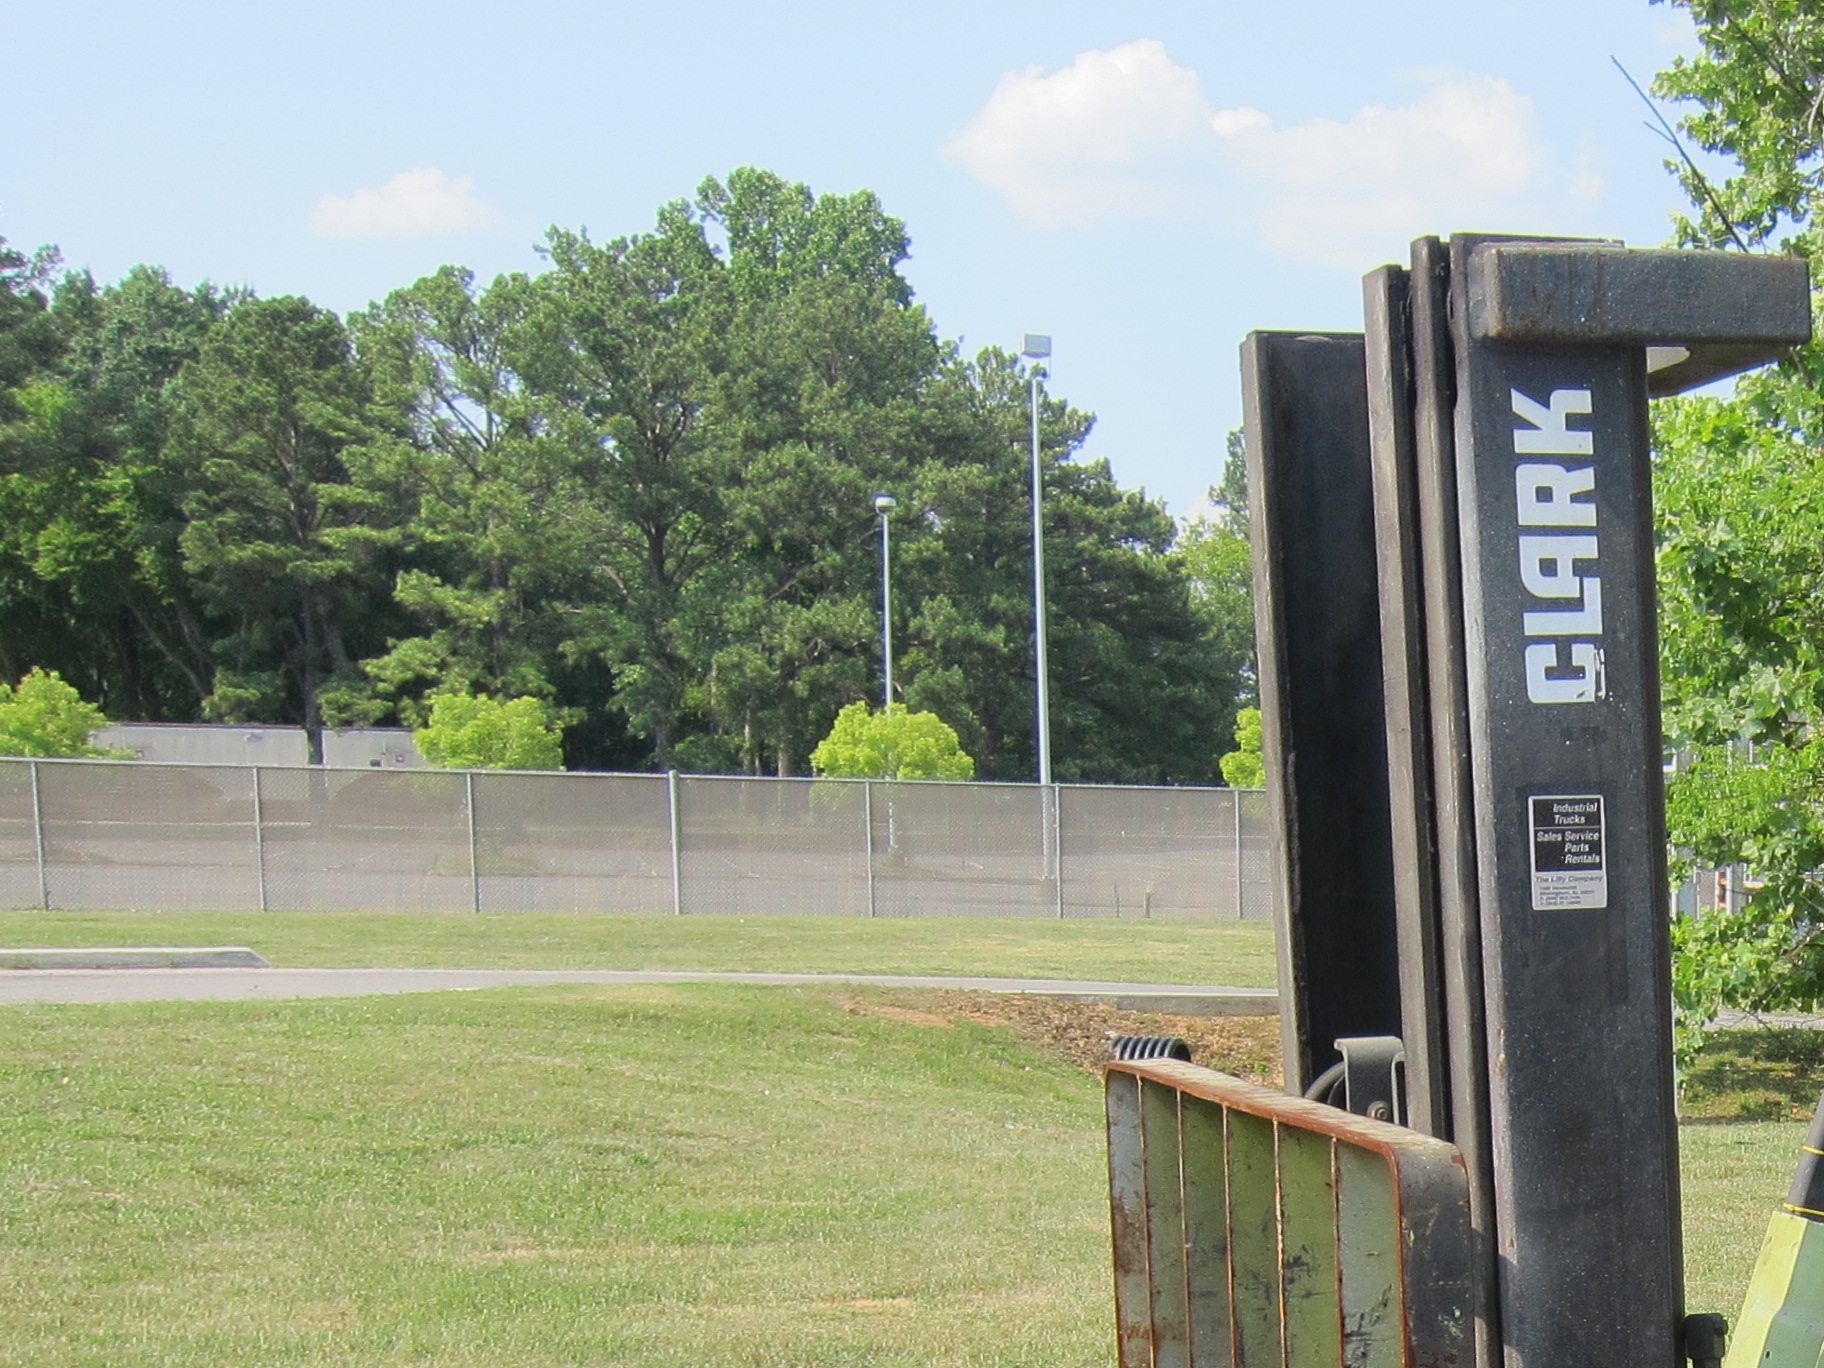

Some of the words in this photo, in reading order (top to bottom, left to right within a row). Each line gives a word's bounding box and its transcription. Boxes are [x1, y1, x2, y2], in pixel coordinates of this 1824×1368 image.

[1510, 388, 1605, 703] CLARK
[1553, 802, 1598, 813] Industrial
[1554, 814, 1586, 824] Trucks
[1537, 831, 1562, 842] Sales
[1564, 830, 1600, 841] Service
[1564, 843, 1590, 853] Parts
[1564, 853, 1601, 864] Rentals
[1568, 875, 1603, 883] Company
